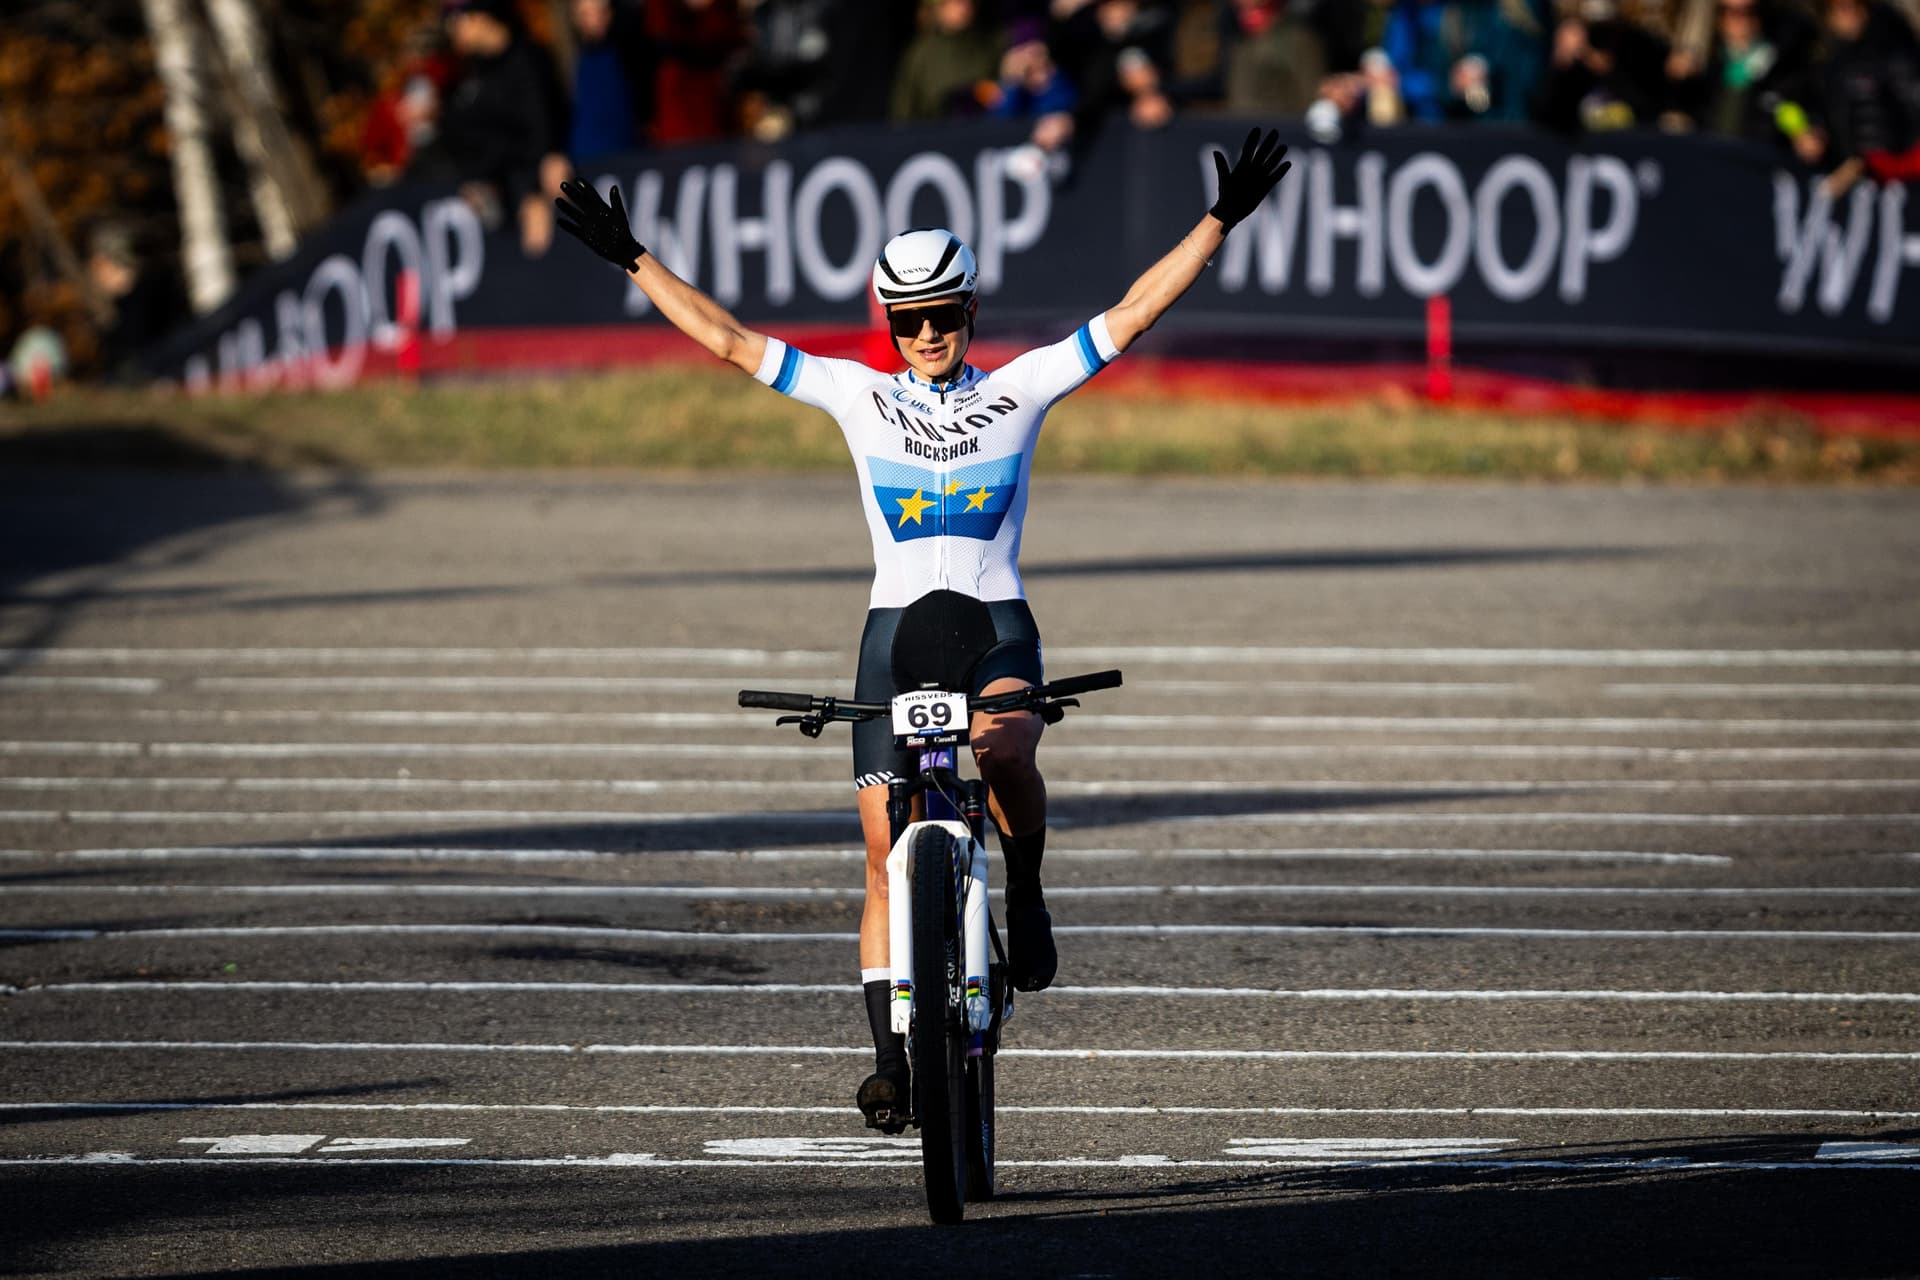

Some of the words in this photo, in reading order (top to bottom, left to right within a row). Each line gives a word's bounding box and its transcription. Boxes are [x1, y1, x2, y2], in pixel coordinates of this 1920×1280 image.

[597, 150, 1051, 317] WHOOP
[1202, 144, 1638, 304] WHOOP
[872, 391, 1019, 442] CANYON
[905, 436, 982, 462] ROCKSHOX
[907, 702, 952, 728] 69
